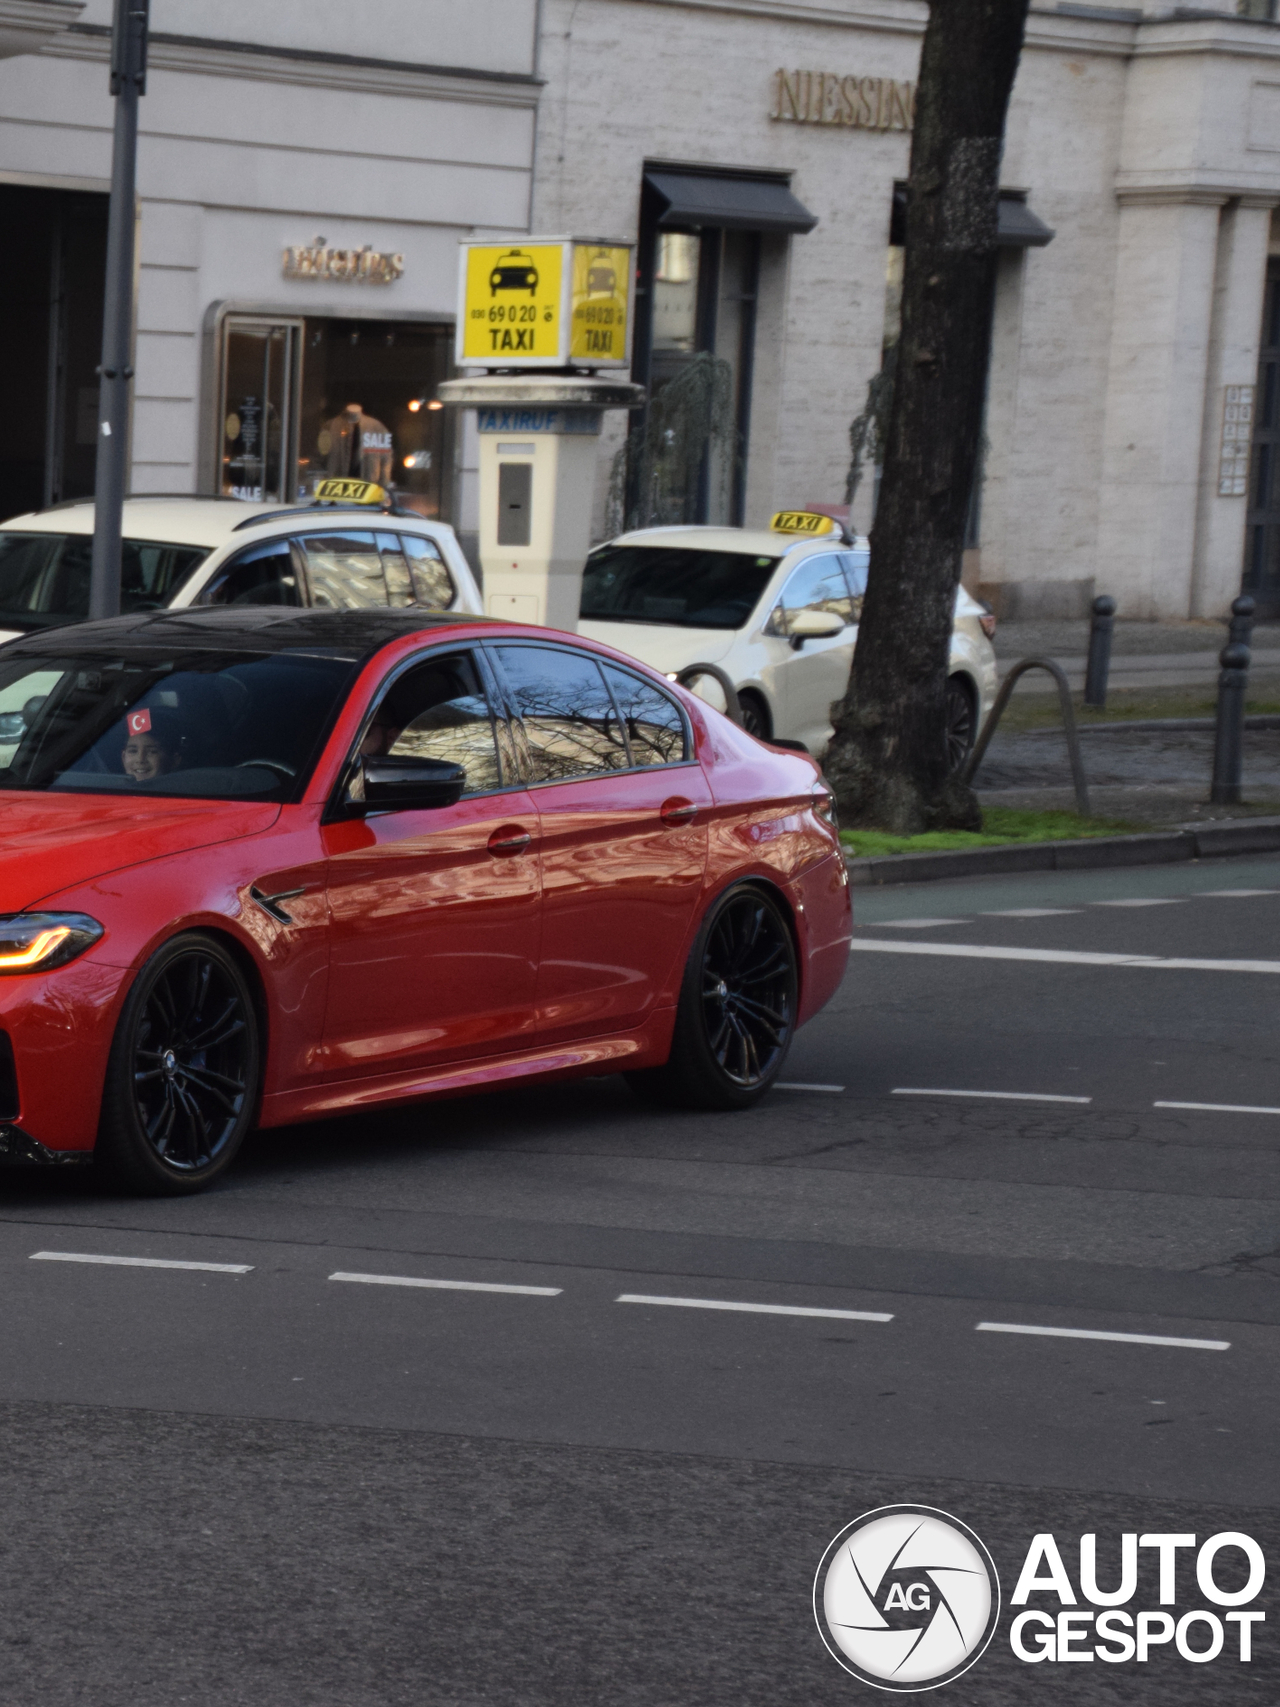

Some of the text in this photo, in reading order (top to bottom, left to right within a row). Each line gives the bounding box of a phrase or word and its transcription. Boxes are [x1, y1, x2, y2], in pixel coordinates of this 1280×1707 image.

[771, 67, 919, 133] NIESSIN
[489, 328, 535, 351] TAXI
[586, 330, 613, 352] TAXI
[478, 410, 559, 430] TAXIRUF
[363, 432, 392, 448] SALE
[232, 486, 262, 501] SALE
[324, 481, 367, 499] TAXI
[780, 514, 819, 530] TAXI
